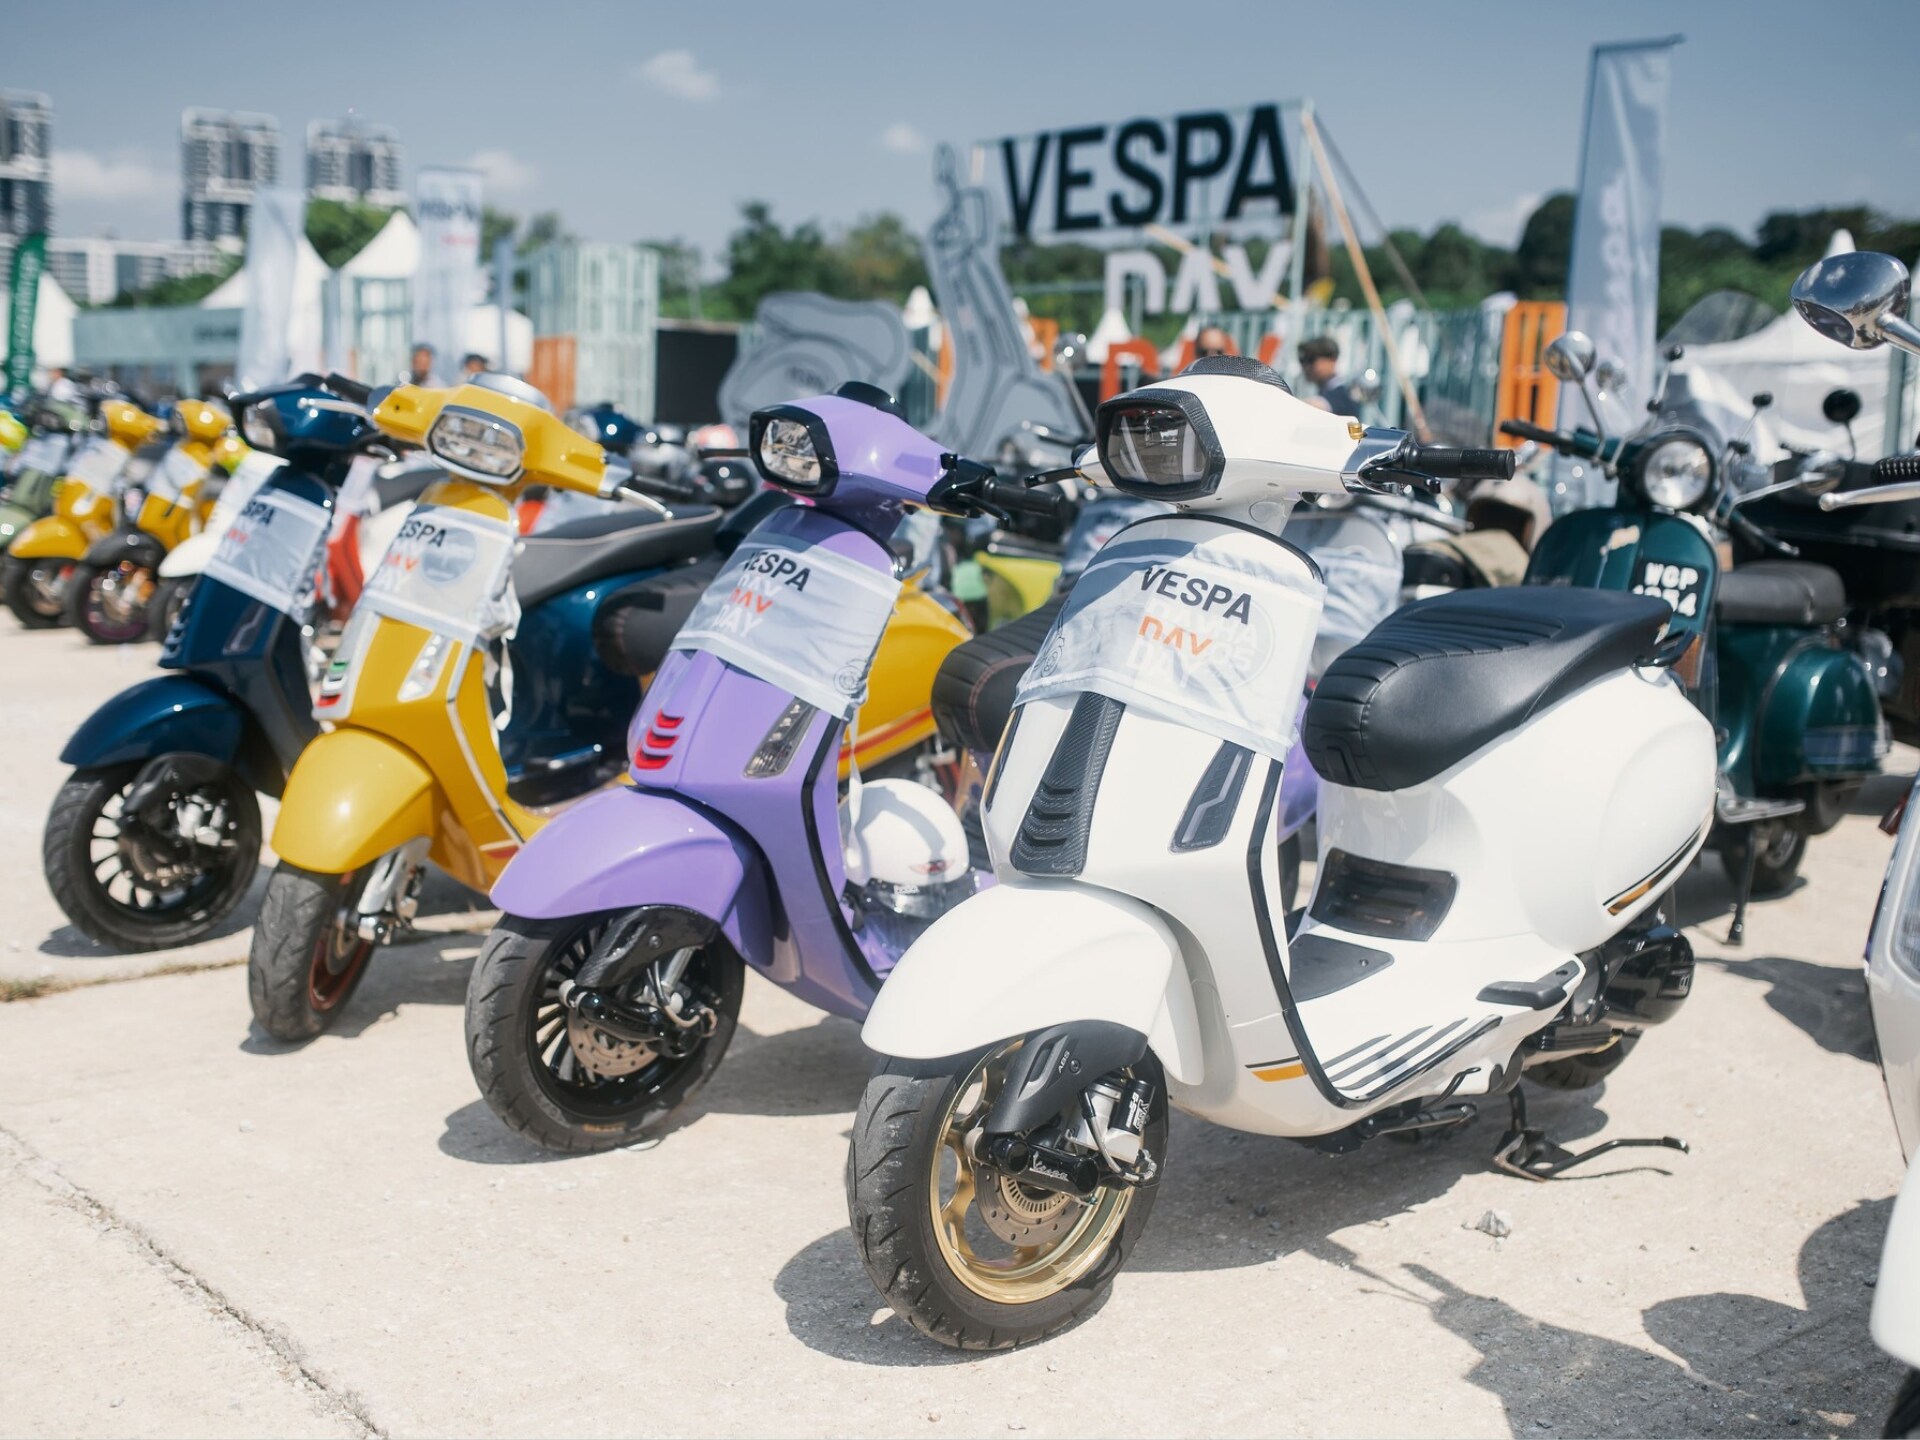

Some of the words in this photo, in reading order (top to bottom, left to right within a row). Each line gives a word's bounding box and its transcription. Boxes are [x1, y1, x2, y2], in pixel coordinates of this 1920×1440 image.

[1002, 103, 1297, 236] VESPA
[241, 500, 275, 525] SPA
[398, 520, 446, 548] ESPA
[743, 551, 811, 591] VESPA
[1141, 566, 1252, 625] VESPA
[1058, 1050, 1070, 1074] ABS
[1029, 1151, 1069, 1181] Vespa
